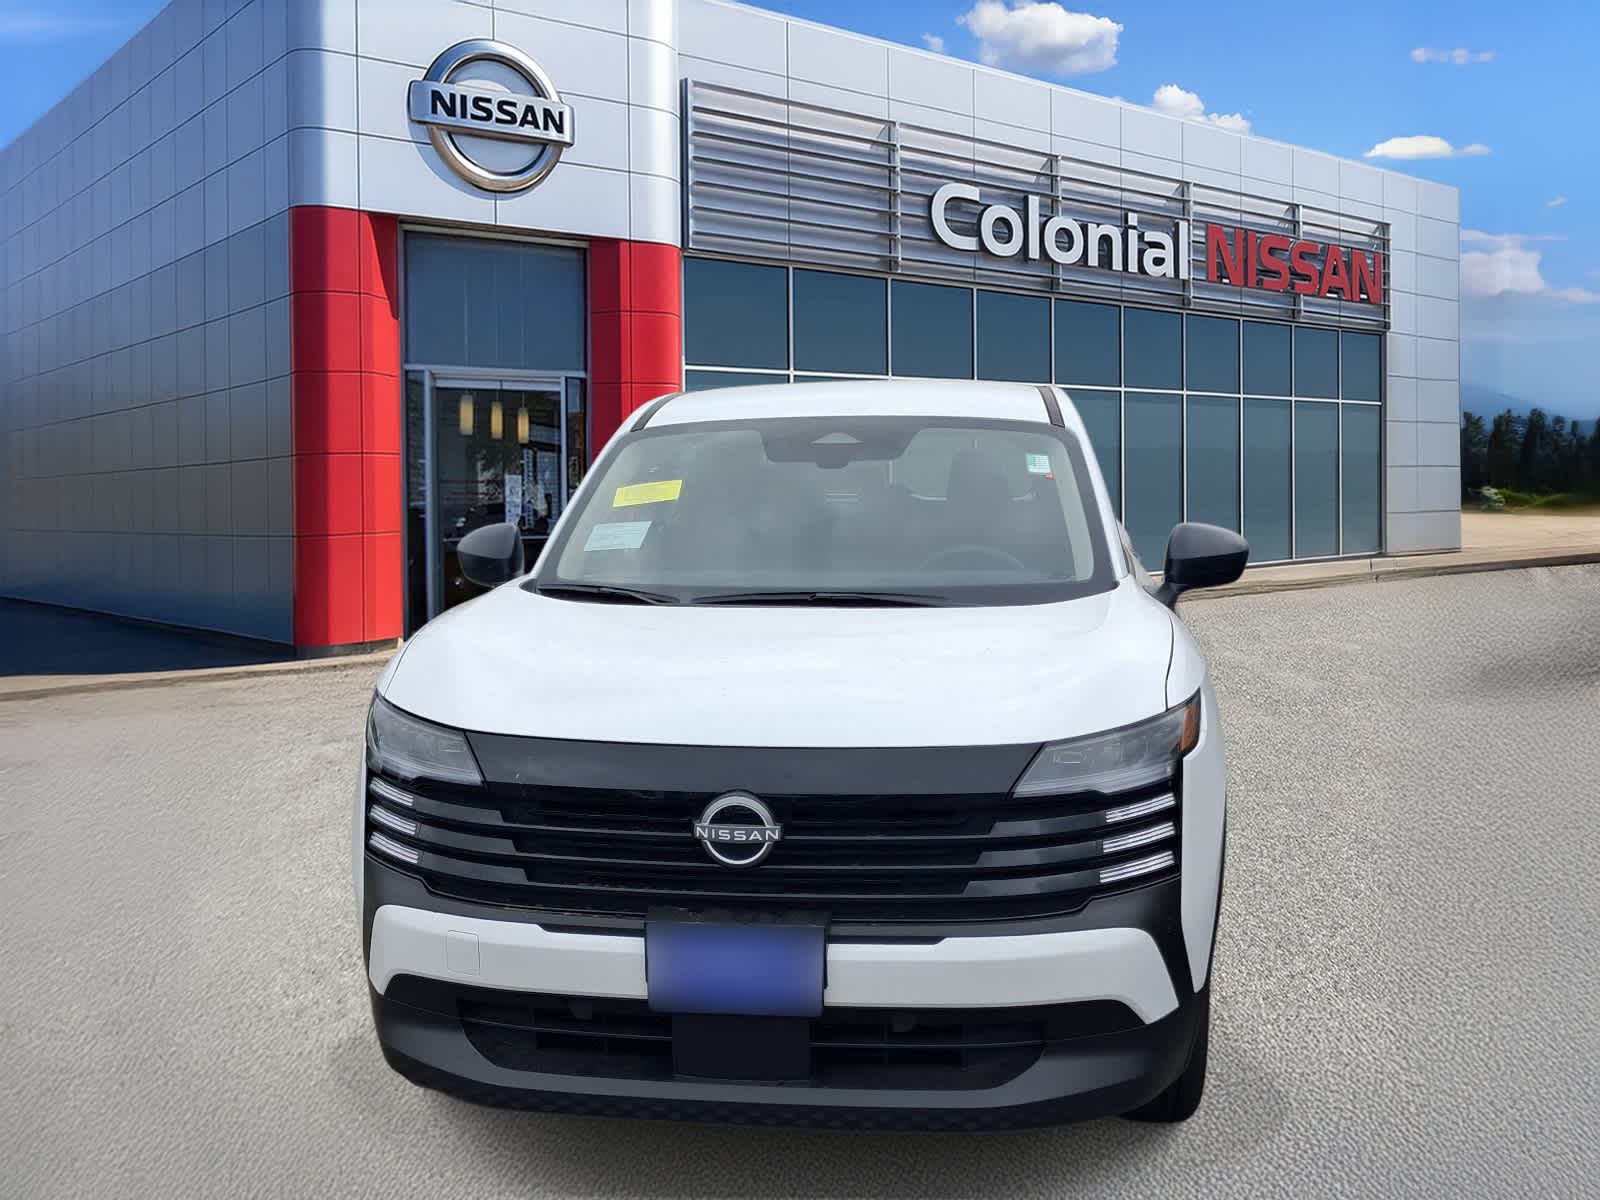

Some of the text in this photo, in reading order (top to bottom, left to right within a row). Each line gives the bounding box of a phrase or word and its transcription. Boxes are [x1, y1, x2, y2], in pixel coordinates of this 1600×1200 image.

[430, 89, 564, 134] NISSAN
[930, 182, 1382, 305] Colonial NISSAN
[696, 826, 779, 841] NISSAN
